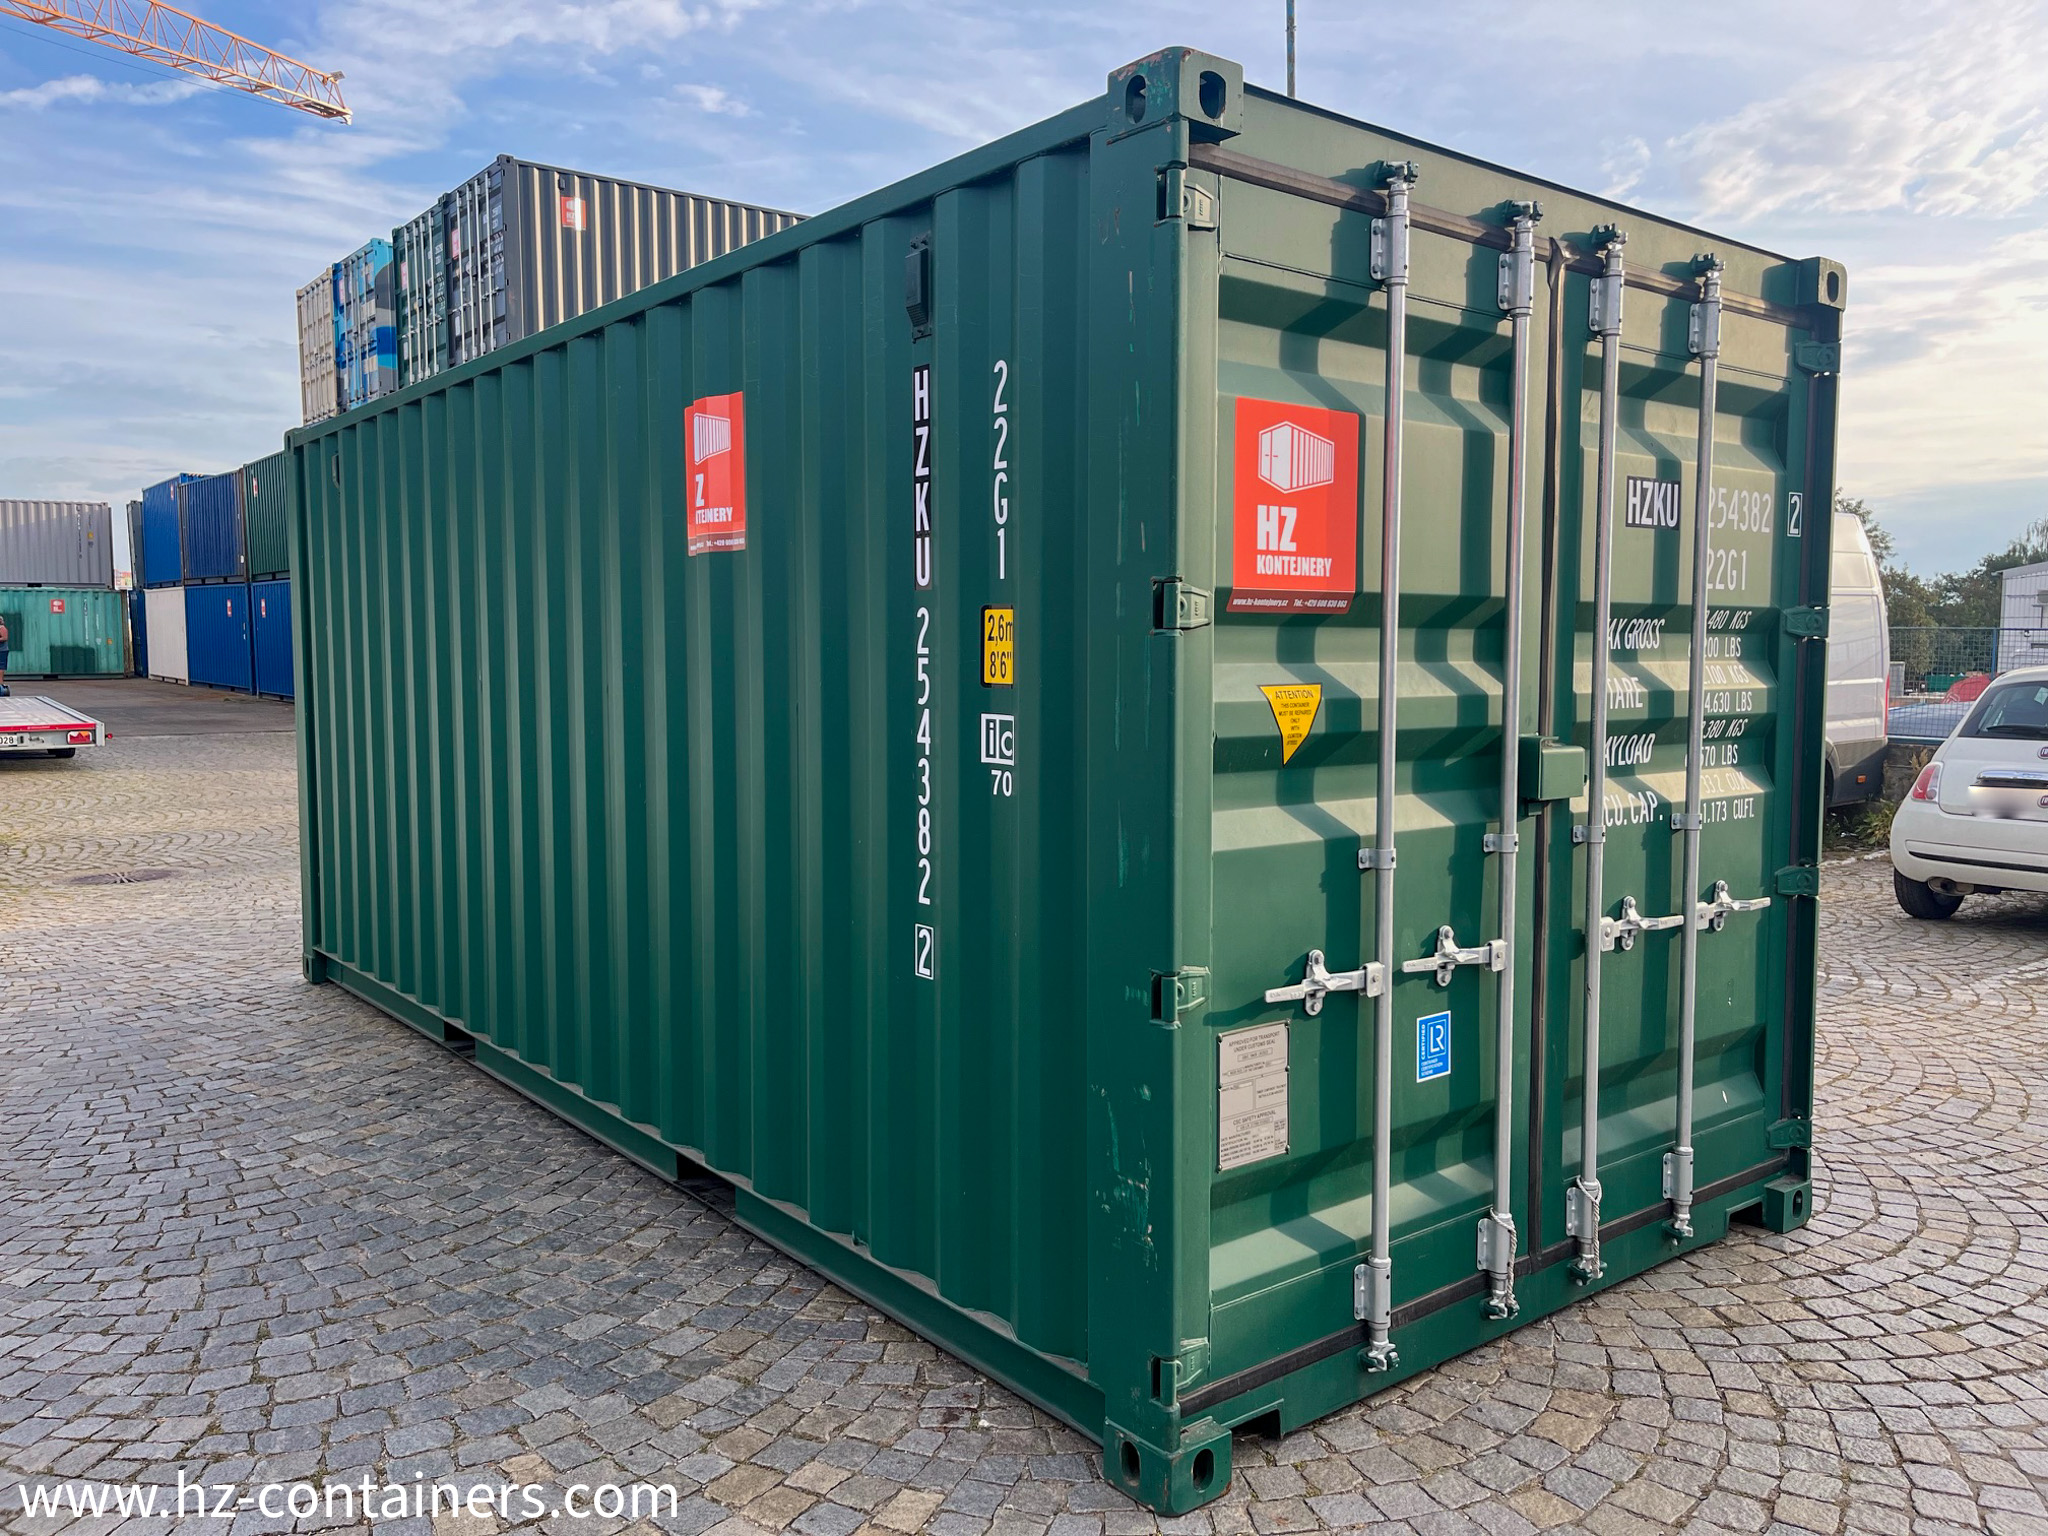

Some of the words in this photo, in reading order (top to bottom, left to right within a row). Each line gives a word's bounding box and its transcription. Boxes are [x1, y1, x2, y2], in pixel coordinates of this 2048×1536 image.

[914, 369, 930, 587] HZKU
[994, 360, 1008, 579] 22G1
[695, 473, 705, 507] Z
[1627, 479, 1679, 527] HZKU
[1788, 494, 1801, 535] 2
[1257, 504, 1297, 552] HZ
[1256, 554, 1332, 577] KONTEJNERY
[1608, 618, 1628, 649] AX
[1625, 618, 1665, 649] GROSS
[1729, 610, 1752, 629] KGS
[1725, 636, 1741, 657] LBS
[989, 651, 1012, 679] 8'6"
[1727, 665, 1749, 683] KGS
[1275, 690, 1314, 700] ATTENTION
[1607, 677, 1643, 709] TARE
[1736, 691, 1752, 712] LBS
[1725, 718, 1748, 737] KGS
[916, 607, 931, 905] 254382
[1604, 731, 1656, 767] AYLOAD
[1721, 744, 1738, 766] LBS
[991, 769, 1012, 797] 70
[917, 928, 932, 975] 2
